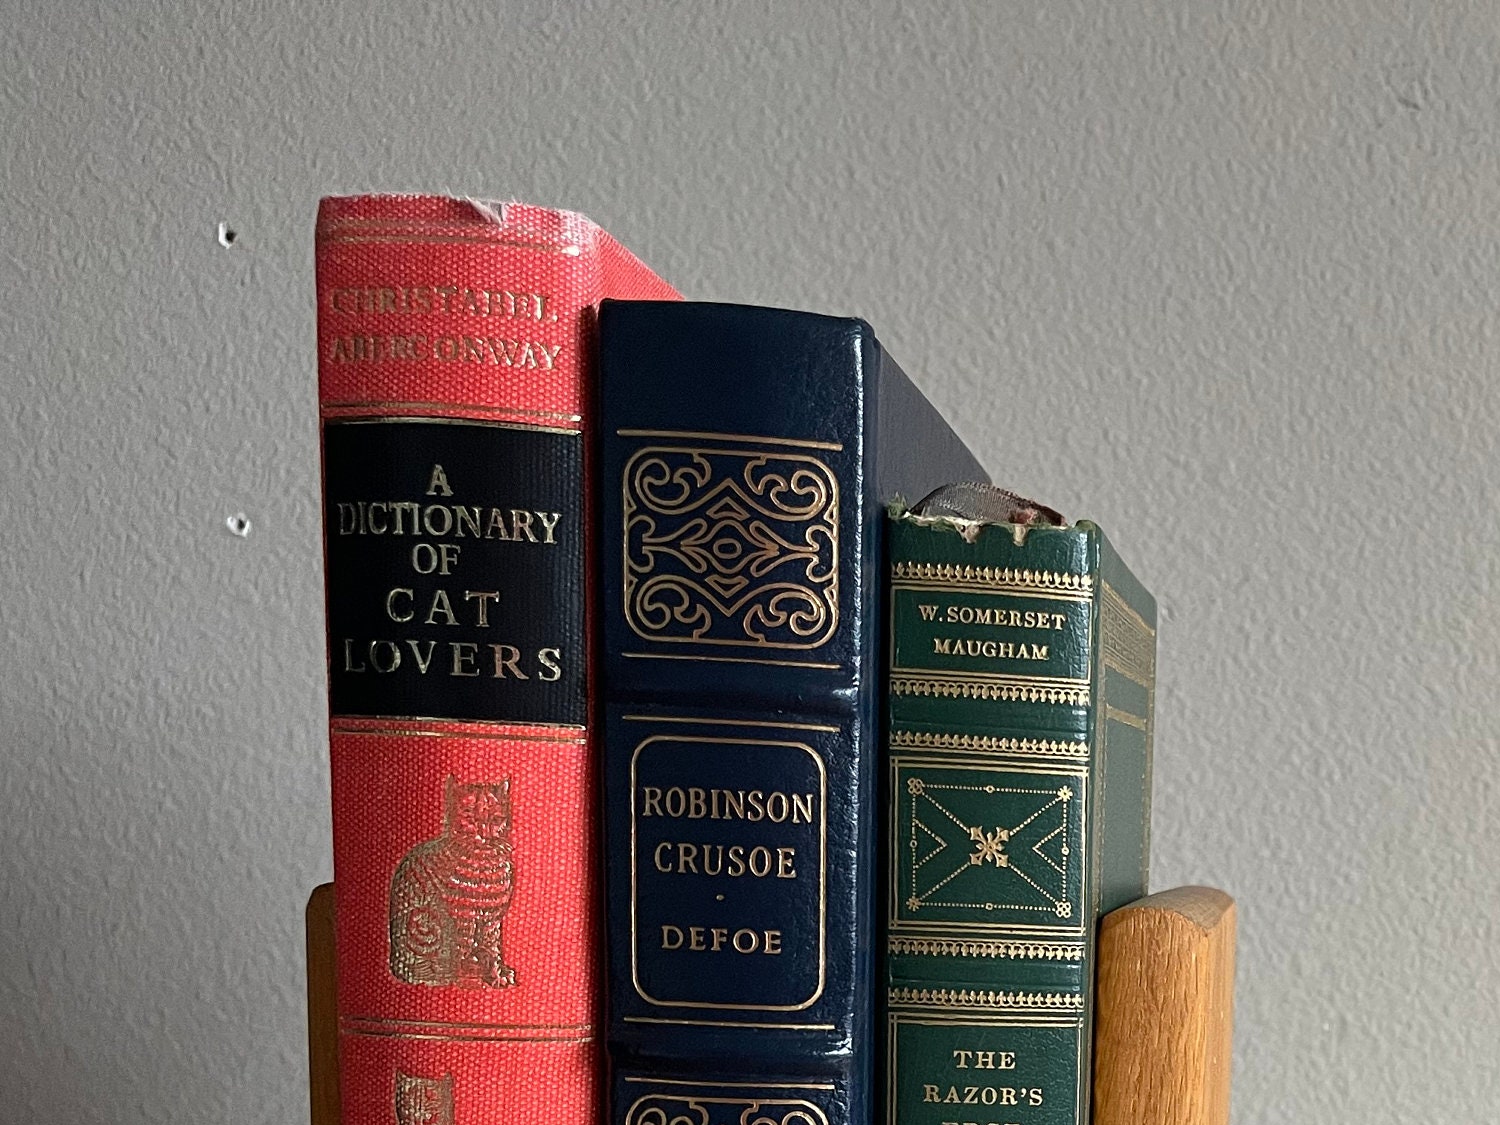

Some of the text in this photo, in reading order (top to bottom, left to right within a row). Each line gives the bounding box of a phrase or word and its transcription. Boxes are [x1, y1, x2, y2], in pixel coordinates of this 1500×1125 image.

[426, 464, 454, 496] A
[337, 501, 562, 544] DICTIONARY
[412, 543, 461, 575] OF
[386, 588, 500, 627] CAT
[344, 639, 562, 681] LOVERS
[933, 638, 1050, 661] MAUGHAM
[642, 787, 813, 824] ROBINSON
[654, 842, 797, 878] CRUSOE
[661, 925, 782, 954] DEFOE
[953, 1050, 1016, 1070] THE
[923, 1084, 1043, 1106] RAZOR'S
